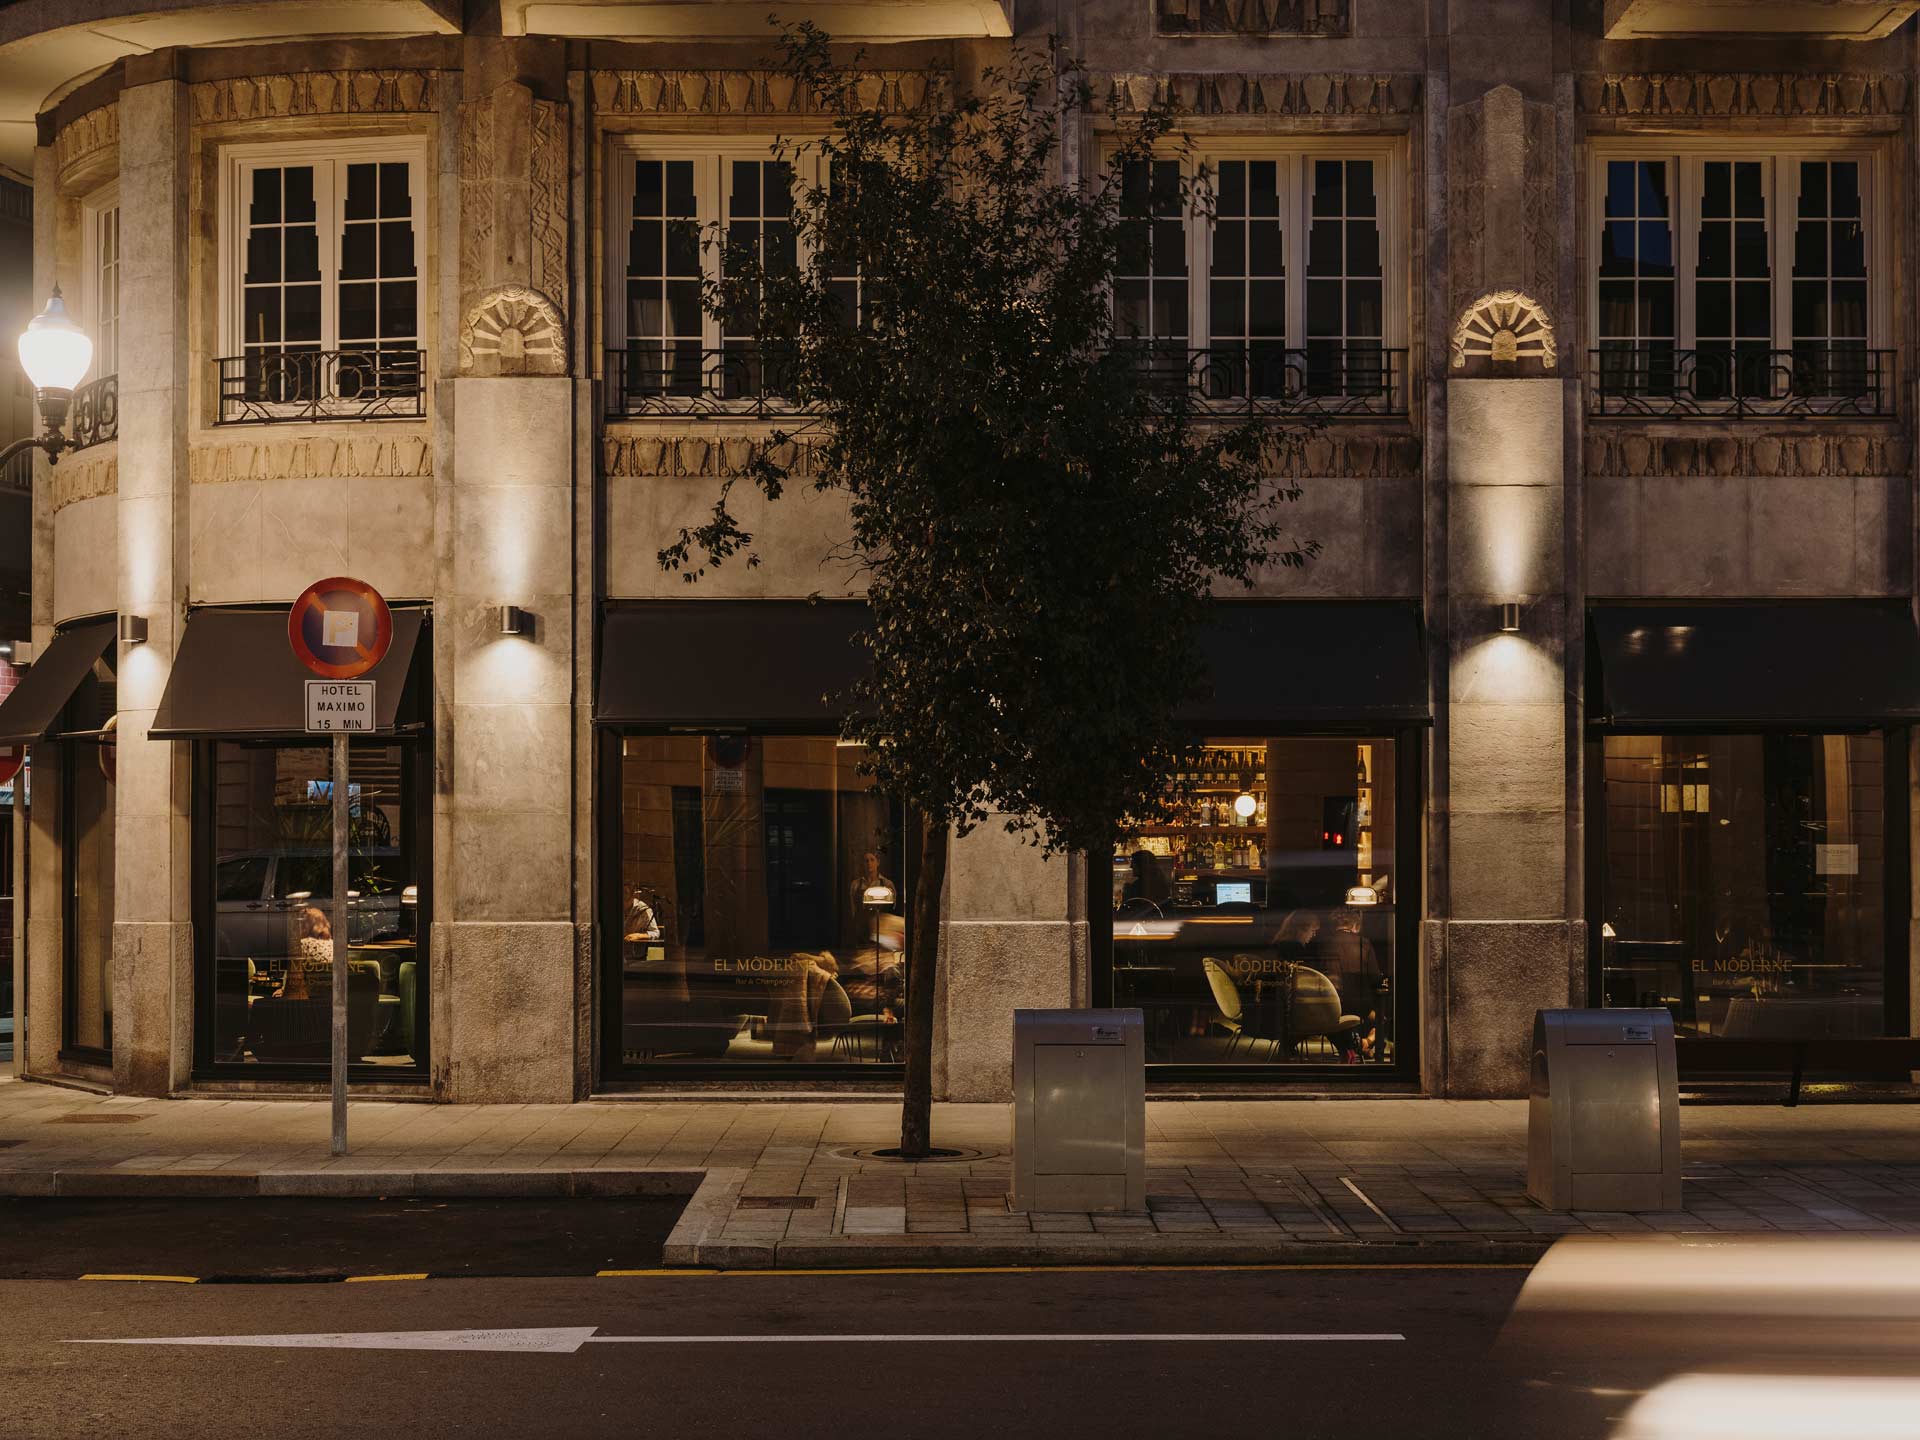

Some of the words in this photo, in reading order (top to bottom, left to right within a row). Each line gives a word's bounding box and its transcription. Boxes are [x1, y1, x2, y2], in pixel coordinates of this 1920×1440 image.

[321, 685, 361, 696] HOTEL
[317, 702, 365, 712] MAXIMO
[317, 719, 331, 730] 15
[343, 719, 362, 729] MIN
[269, 959, 288, 972] EL
[713, 958, 732, 972] EL
[1203, 959, 1220, 973] EL
[1691, 959, 1709, 972] EL
